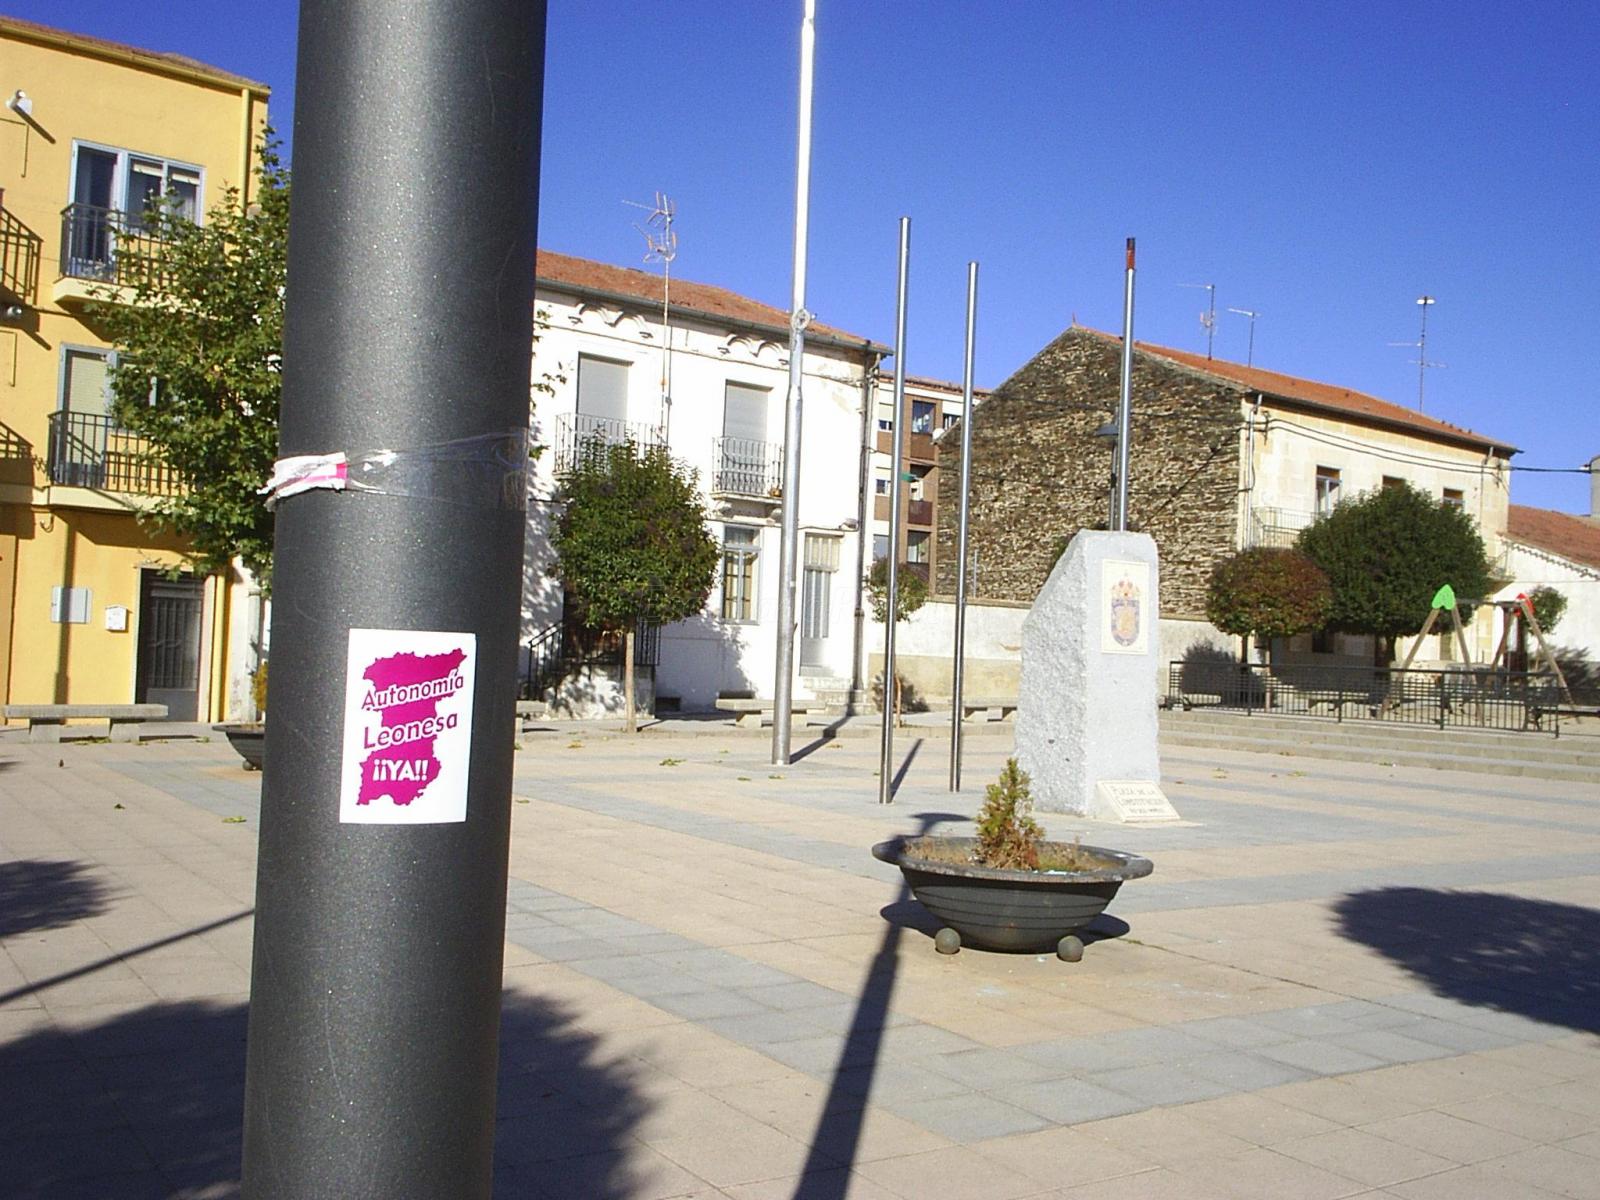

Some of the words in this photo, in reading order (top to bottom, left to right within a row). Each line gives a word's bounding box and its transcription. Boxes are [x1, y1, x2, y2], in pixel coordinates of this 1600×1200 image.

[362, 669, 465, 710] Autonomía
[363, 712, 459, 750] Leonesa
[372, 759, 429, 782] ¡¡YA!!
